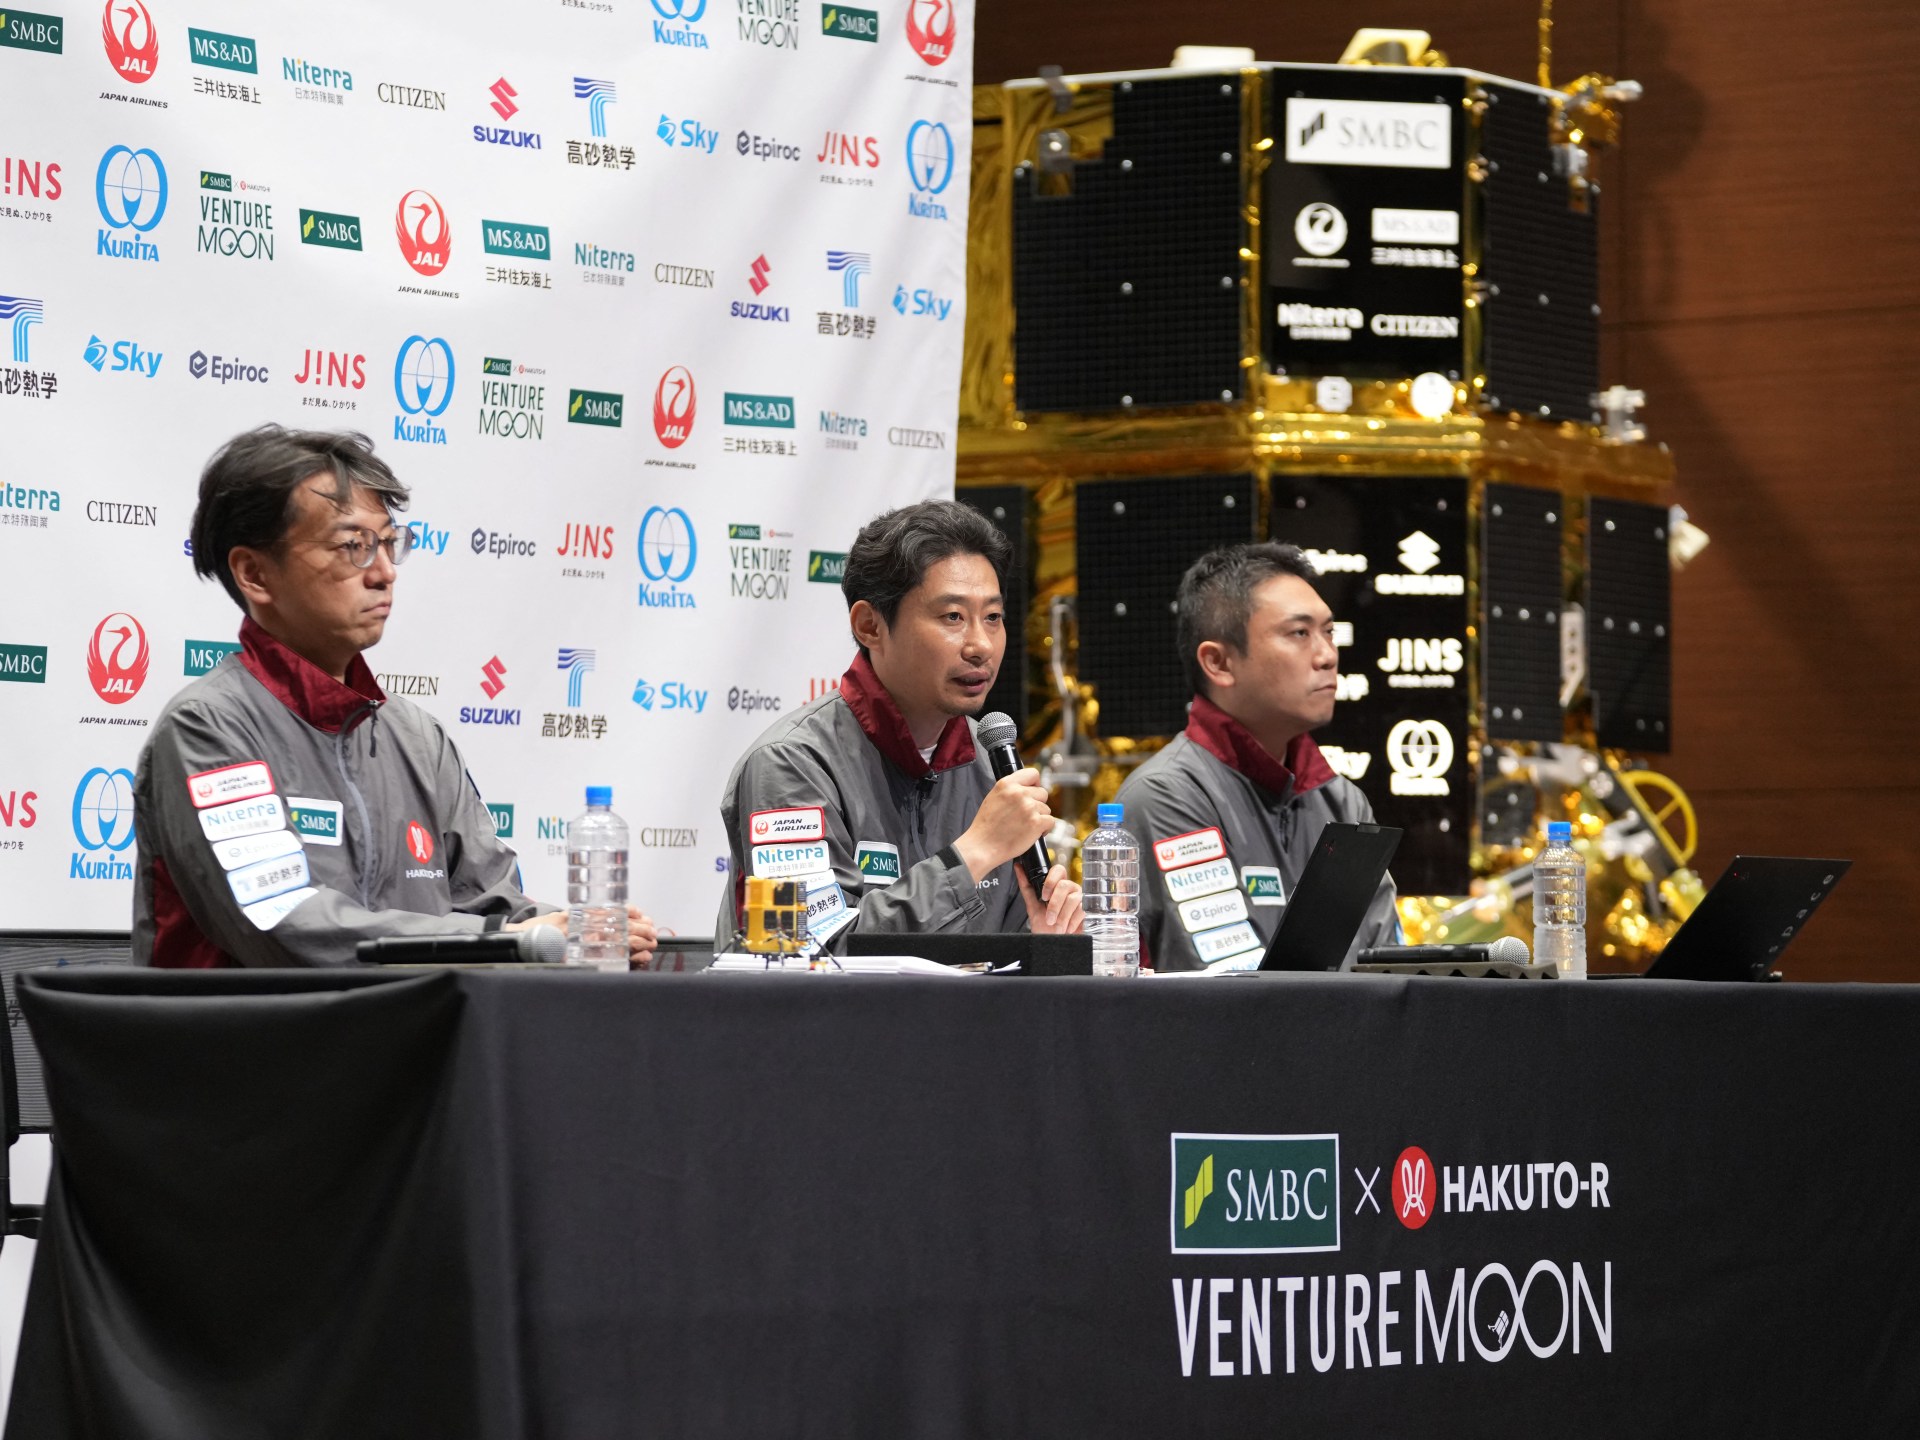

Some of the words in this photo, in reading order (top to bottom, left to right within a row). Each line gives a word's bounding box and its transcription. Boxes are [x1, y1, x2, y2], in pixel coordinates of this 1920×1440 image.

[10, 20, 59, 45] SMBC
[738, 16, 799, 50] MOON
[838, 14, 877, 36] SMBC
[194, 37, 253, 65] MS&AD
[120, 56, 150, 75] JAL
[282, 57, 353, 90] Niterra
[100, 92, 127, 102] JAPAN
[129, 97, 168, 109] AIRLINES
[193, 77, 262, 104] 三井住友海上
[378, 82, 446, 111] CITIZEN
[473, 125, 541, 149] SUZUKI
[680, 120, 719, 154] Sky
[1338, 117, 1439, 150] SMBC
[566, 140, 636, 170] 高砂熱学
[753, 136, 800, 161] Epiroc
[209, 176, 231, 188] SMBC
[200, 195, 273, 230] VENTURE
[198, 225, 274, 261] MOON
[318, 220, 359, 243] SMBC
[488, 228, 547, 252] MS&AD
[412, 250, 443, 267] JAL
[575, 242, 635, 272] Niterra
[486, 267, 552, 289] 三井住友海上
[654, 263, 714, 288] CITIZEN
[398, 286, 422, 295] JAPAN
[423, 289, 460, 299] AIRLINES
[913, 289, 953, 320] Sky
[731, 301, 790, 322] SUZUKI
[816, 311, 876, 340] 高砂熱学
[111, 341, 163, 377] Sky
[211, 356, 269, 384] Epiroc
[0, 368, 57, 399] 砂熱学
[482, 380, 545, 411] VENTURE
[585, 399, 621, 420] SMBC
[728, 399, 791, 421] MS&AD
[479, 408, 544, 441] MOON
[660, 424, 687, 441] JAL
[819, 410, 868, 436] Niterra
[723, 437, 797, 457] 三井住友海上
[888, 426, 946, 449] CITIZEN
[0, 481, 60, 512] iterra
[86, 500, 157, 527] CITIZEN
[407, 521, 450, 555] Sky
[489, 532, 537, 559] Epiroc
[730, 546, 792, 572] VENTURE
[731, 572, 790, 600] MOON
[101, 677, 135, 695] JAL
[661, 682, 708, 713] Sky
[741, 690, 781, 715] Epiroc
[79, 716, 107, 725] JAPAN
[108, 717, 148, 727] AIRLINES
[459, 706, 521, 726] SUZUKI
[542, 712, 608, 739] 高砂熱学
[206, 803, 277, 827] Niterra
[301, 814, 335, 832] SMBC
[641, 828, 698, 848] CITIZEN
[774, 824, 819, 832] AIRLINES
[757, 846, 824, 865] Niterra
[872, 857, 898, 872] SMBC
[1170, 865, 1229, 889] Niterra
[1257, 879, 1280, 893] SMBC
[1203, 902, 1238, 918] Epiroc
[1226, 1168, 1328, 1222] SMBC
[1443, 1161, 1611, 1213] HAKUTO-R
[1172, 1270, 1402, 1377] VENTURE
[1415, 1259, 1612, 1365] MOON
